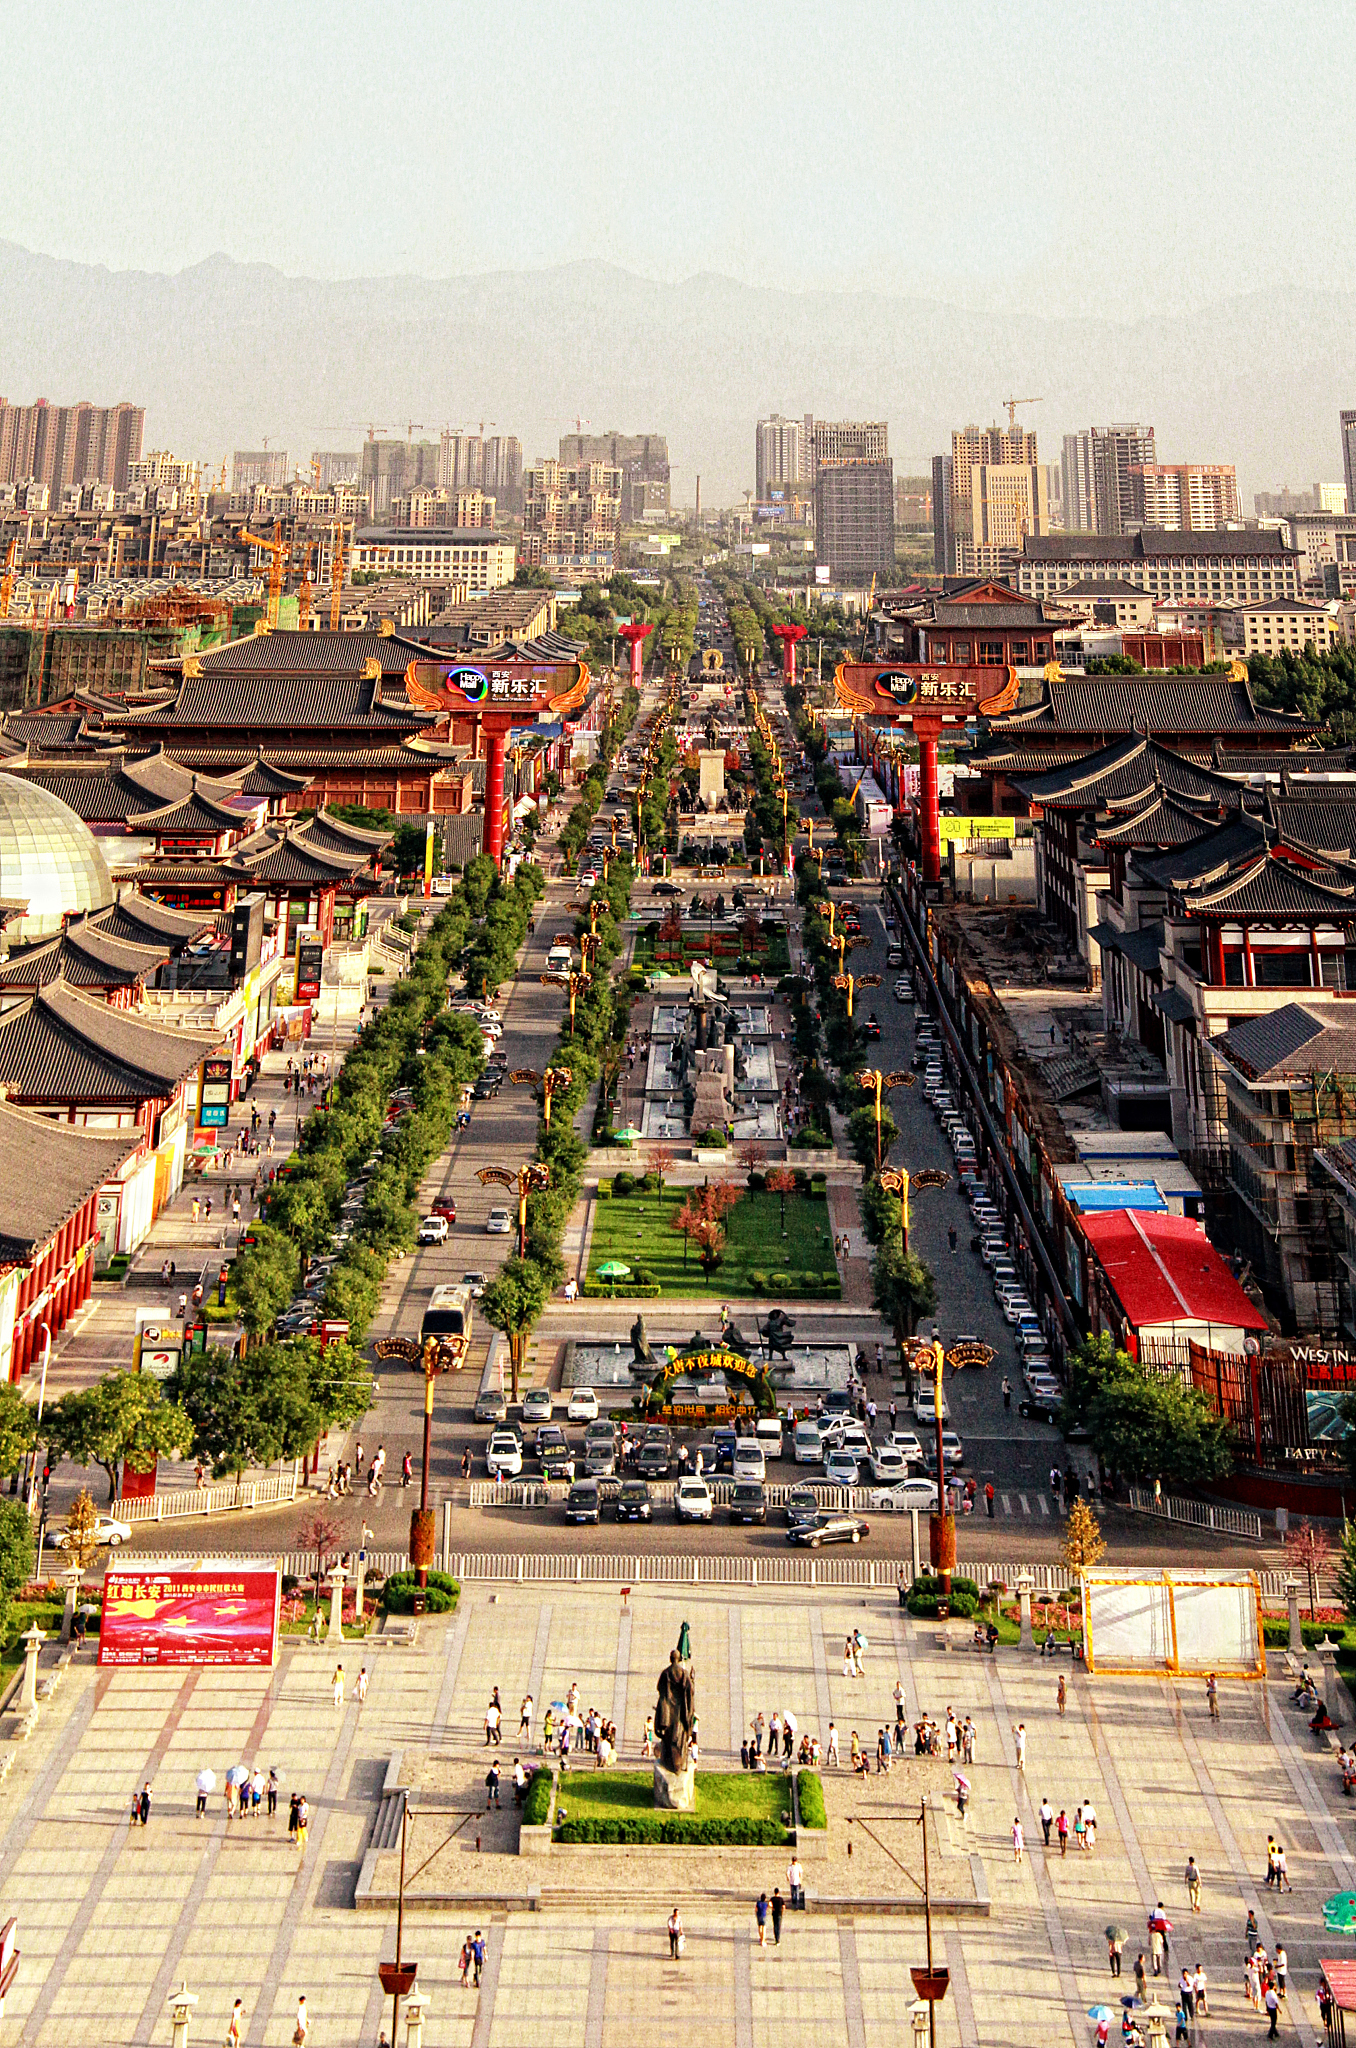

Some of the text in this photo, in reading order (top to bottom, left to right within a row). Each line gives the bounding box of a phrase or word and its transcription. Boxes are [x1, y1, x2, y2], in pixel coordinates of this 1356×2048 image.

[460, 673, 485, 682] Happy
[491, 670, 510, 679] 西安
[920, 673, 939, 681] 西安
[460, 681, 478, 689] Mall
[890, 675, 914, 686] Happy
[491, 678, 548, 694] 新乐汇
[890, 683, 908, 692] Mall
[920, 681, 977, 697] 新乐汇
[661, 1353, 759, 1381] 大唐不夜城欢迎您
[106, 1584, 161, 1599] 红遍长安
